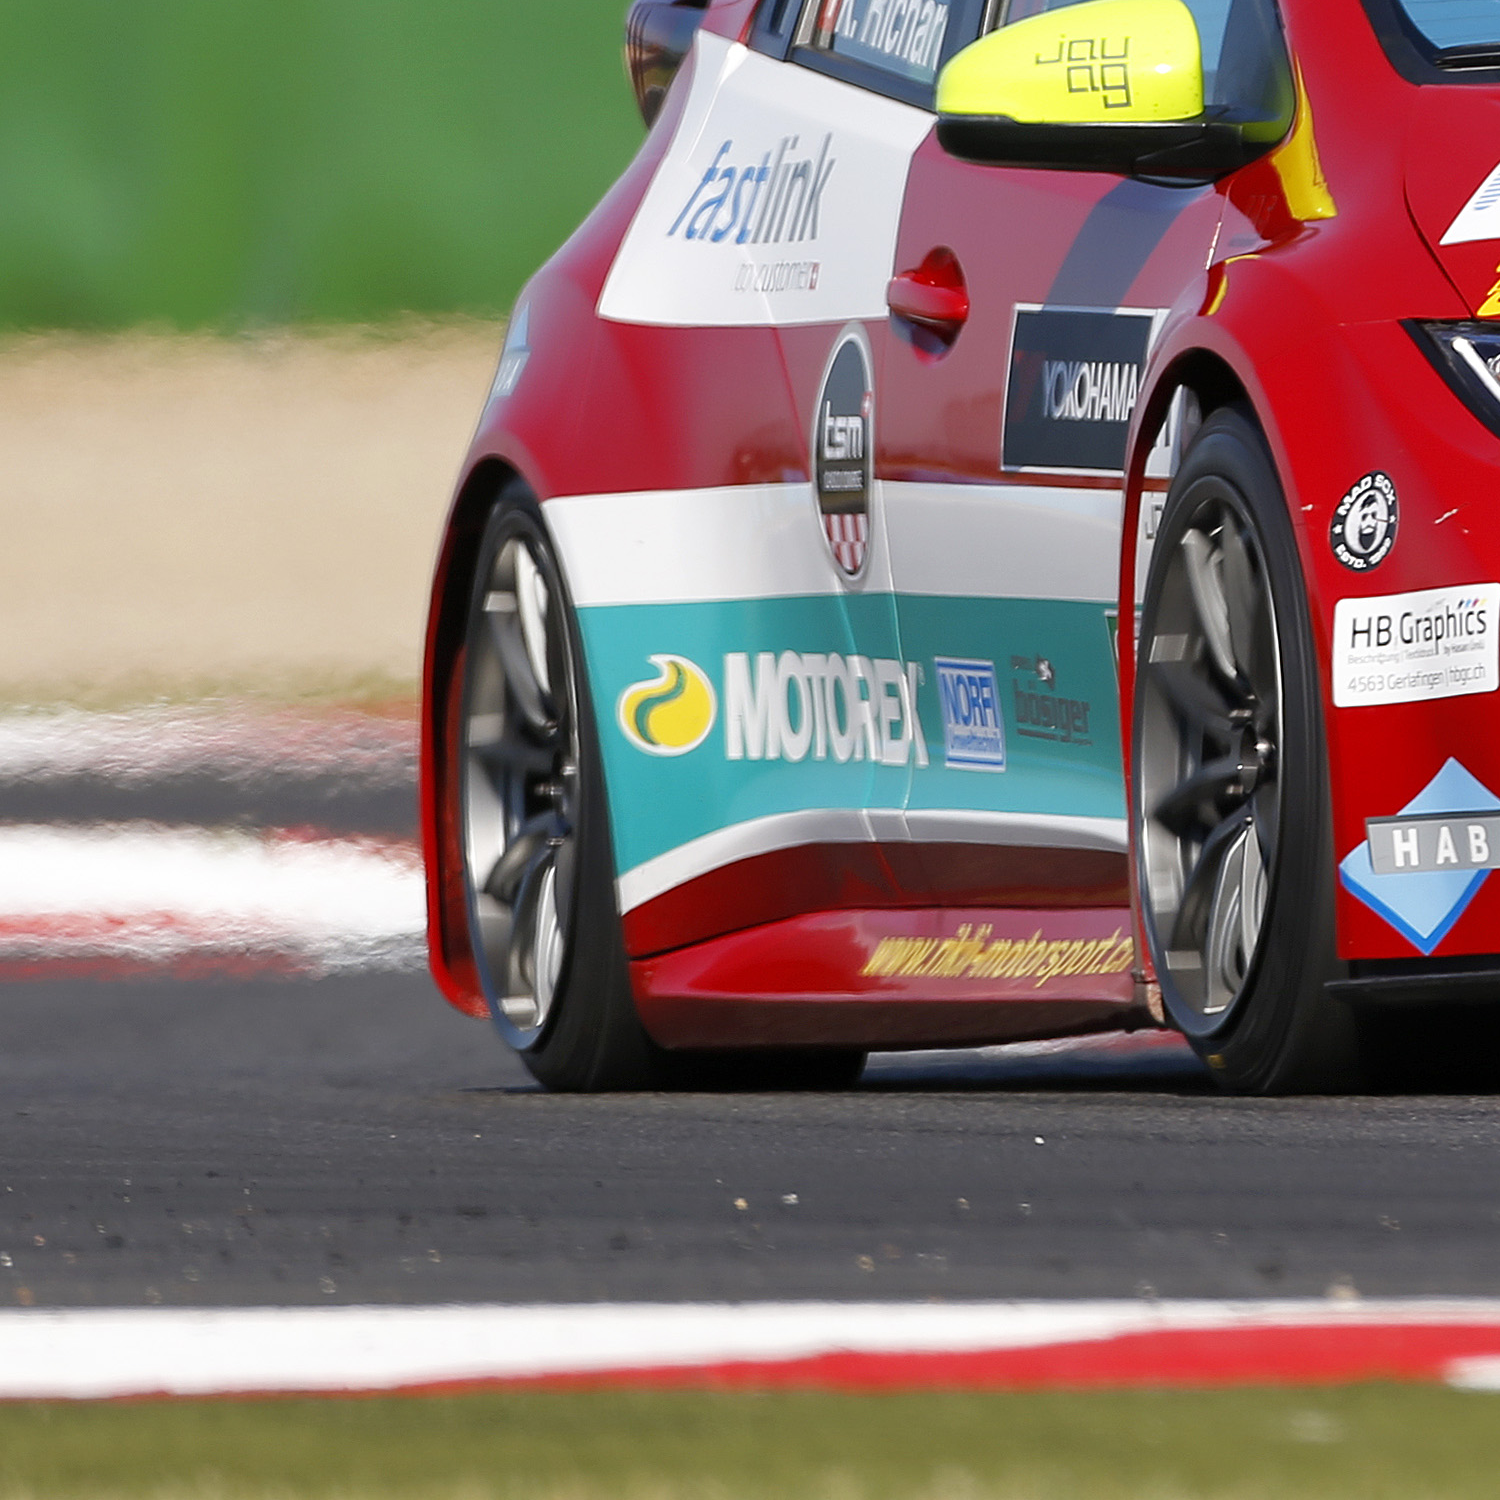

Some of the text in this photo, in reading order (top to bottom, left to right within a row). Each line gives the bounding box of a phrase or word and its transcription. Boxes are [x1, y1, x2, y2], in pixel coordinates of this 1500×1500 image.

[667, 132, 836, 244] fastlink
[1043, 361, 1138, 421] YOKOHAMA
[1337, 474, 1396, 516] MAD SOX
[1335, 543, 1367, 569] ESTD.
[1351, 603, 1487, 655] HB Graphics
[724, 650, 930, 768] MOTOREX
[1348, 674, 1386, 693] 4563
